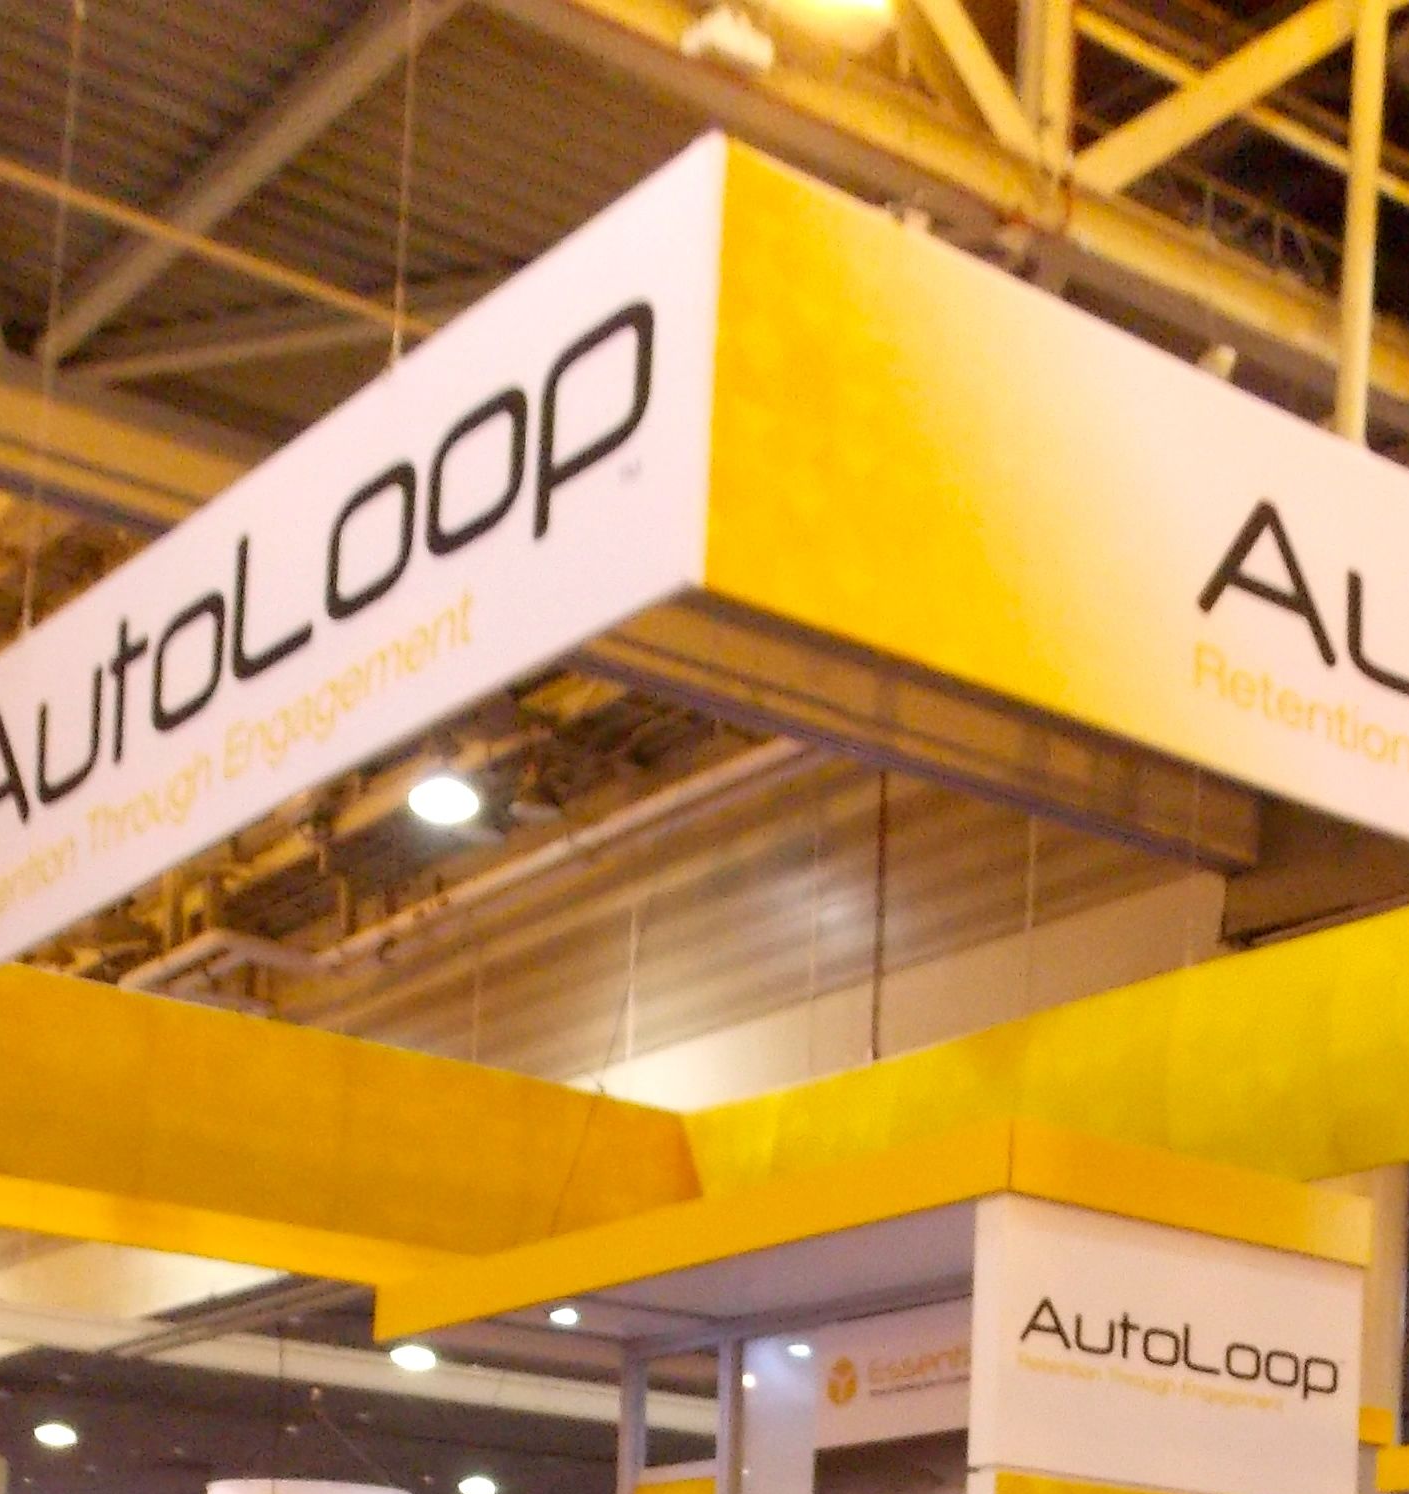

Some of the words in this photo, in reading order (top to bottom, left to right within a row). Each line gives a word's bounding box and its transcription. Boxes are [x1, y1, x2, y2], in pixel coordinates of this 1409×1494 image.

[86, 752, 212, 851] Through
[222, 585, 475, 782] Engagement
[1020, 1297, 1339, 1400] AutoLoop
